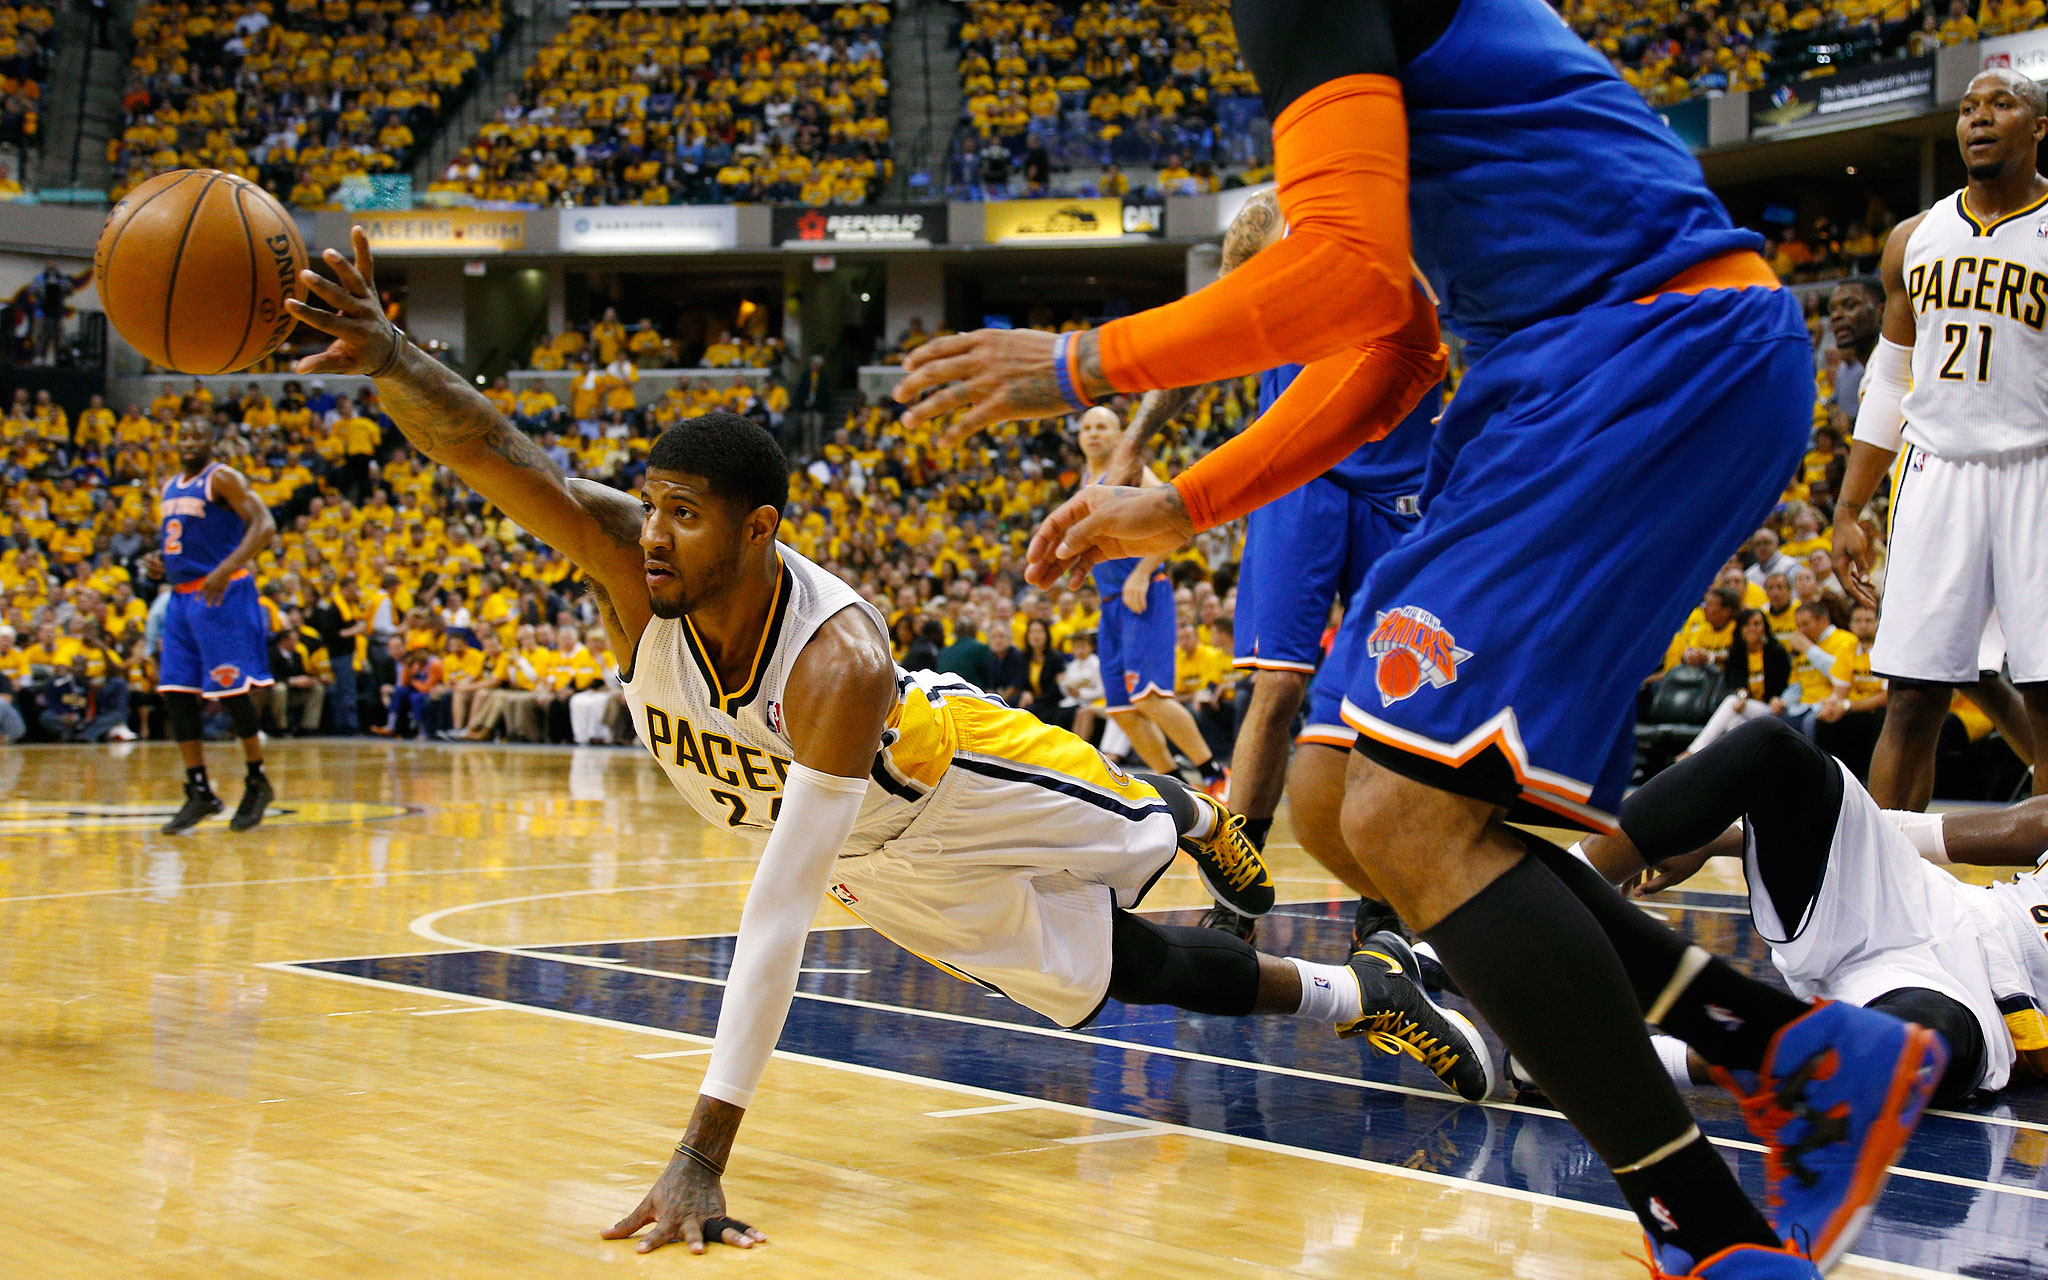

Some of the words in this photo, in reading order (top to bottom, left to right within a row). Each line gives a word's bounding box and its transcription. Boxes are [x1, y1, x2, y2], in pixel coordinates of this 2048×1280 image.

[826, 213, 924, 232] REPUBLIC
[1123, 205, 1162, 232] CAT
[1909, 256, 2048, 331] PACERS
[1940, 324, 1992, 381] 21
[164, 518, 183, 555] 2
[1369, 610, 1455, 681] KNICKS
